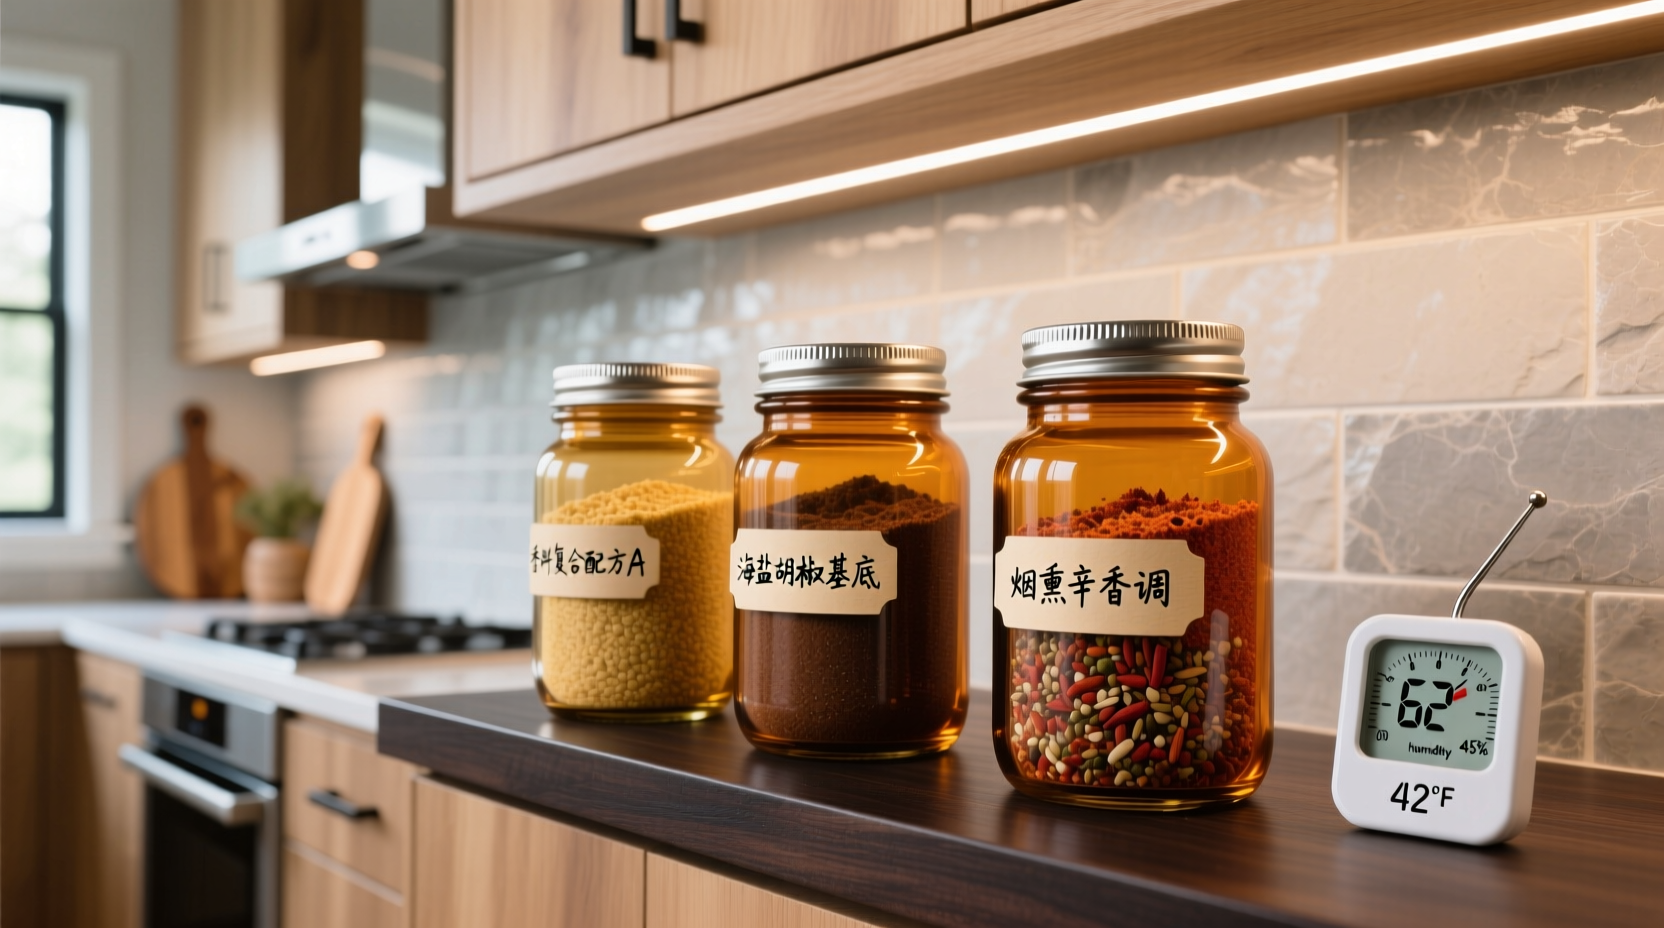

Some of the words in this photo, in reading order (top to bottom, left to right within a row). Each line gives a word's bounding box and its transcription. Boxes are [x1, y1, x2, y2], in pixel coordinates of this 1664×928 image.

[737, 553, 881, 589] 海盐胡椒基底
[1011, 562, 1170, 608] 烟熏辛香调
[1397, 678, 1454, 732] 62
[1459, 740, 1488, 756] 45%
[1390, 782, 1455, 814] 42°F
